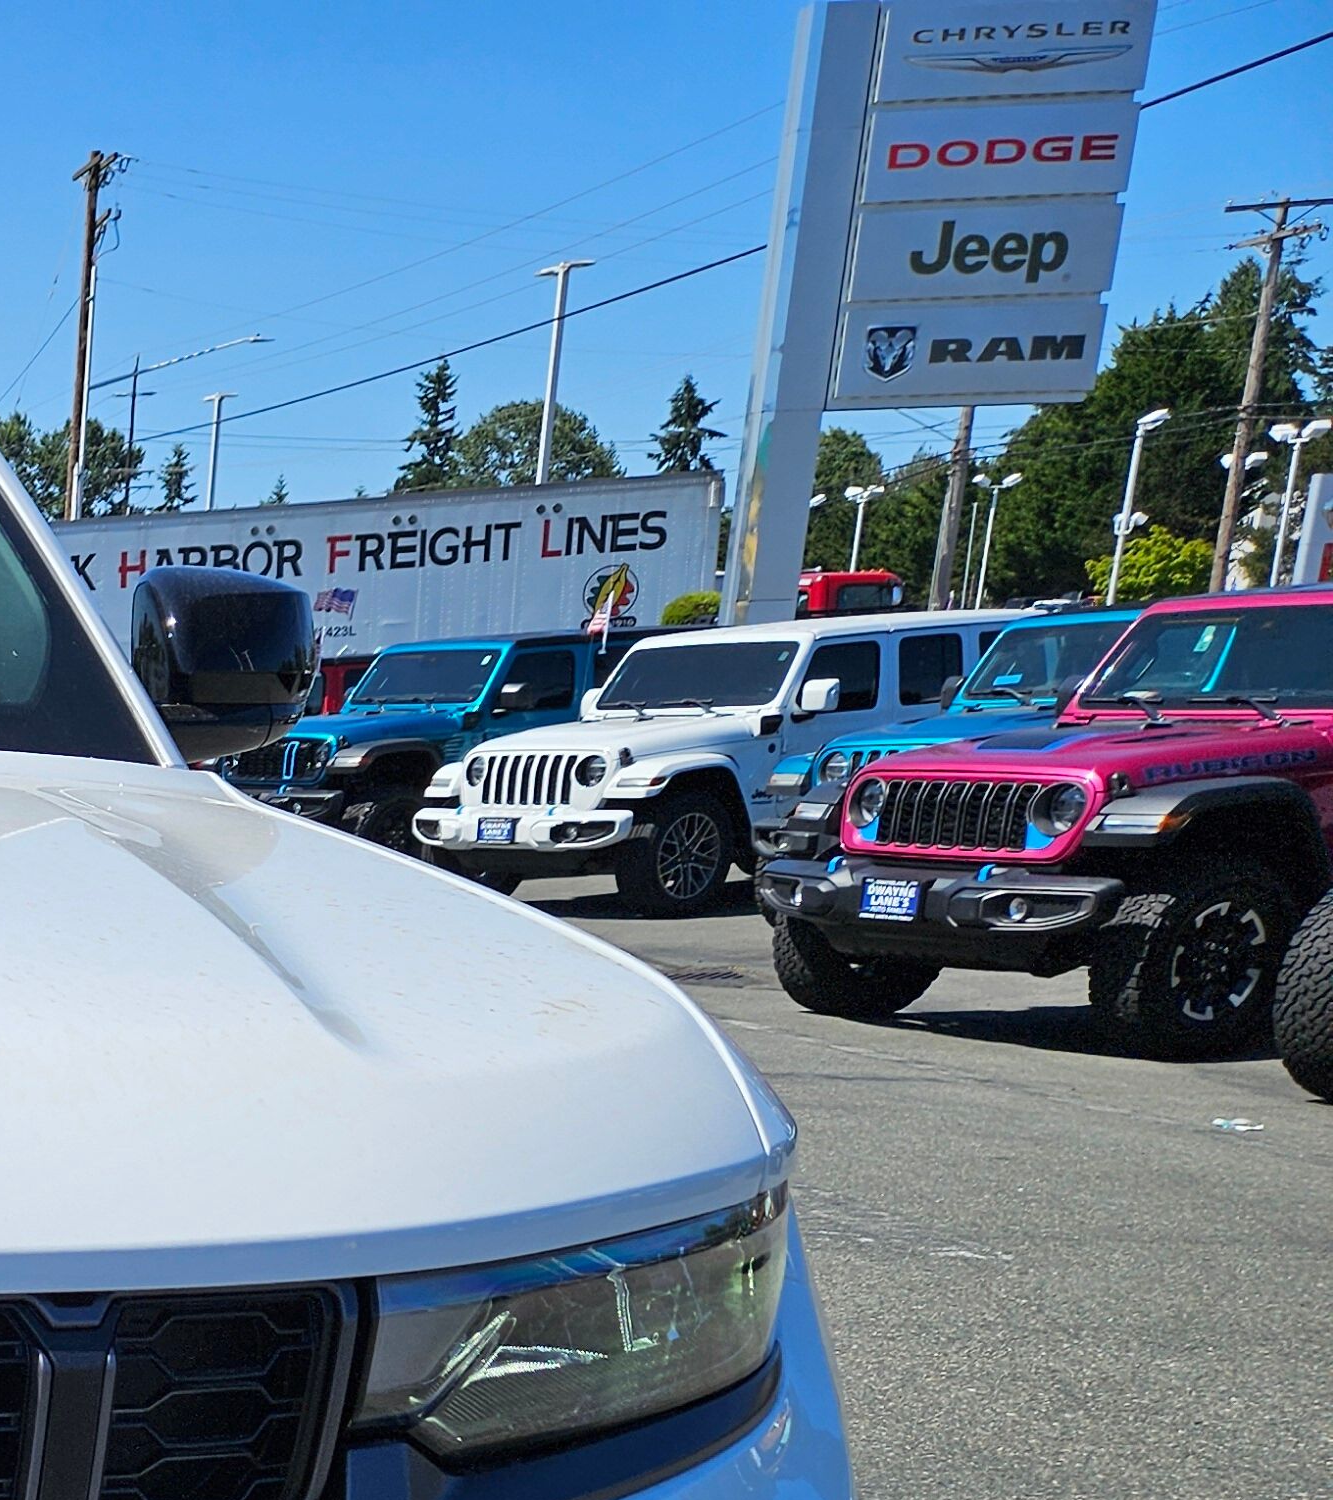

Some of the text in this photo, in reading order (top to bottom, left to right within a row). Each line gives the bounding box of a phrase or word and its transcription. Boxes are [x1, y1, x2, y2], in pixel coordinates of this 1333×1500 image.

[913, 21, 1131, 44] CHRYSLER
[887, 134, 1119, 170] DODGE
[910, 220, 1069, 283] Jeep
[929, 334, 1086, 364] RAM
[71, 552, 96, 591] K
[1144, 750, 1318, 783] RUBICON
[867, 884, 917, 898] DWAYNE
[870, 894, 910, 908] LANE'S
